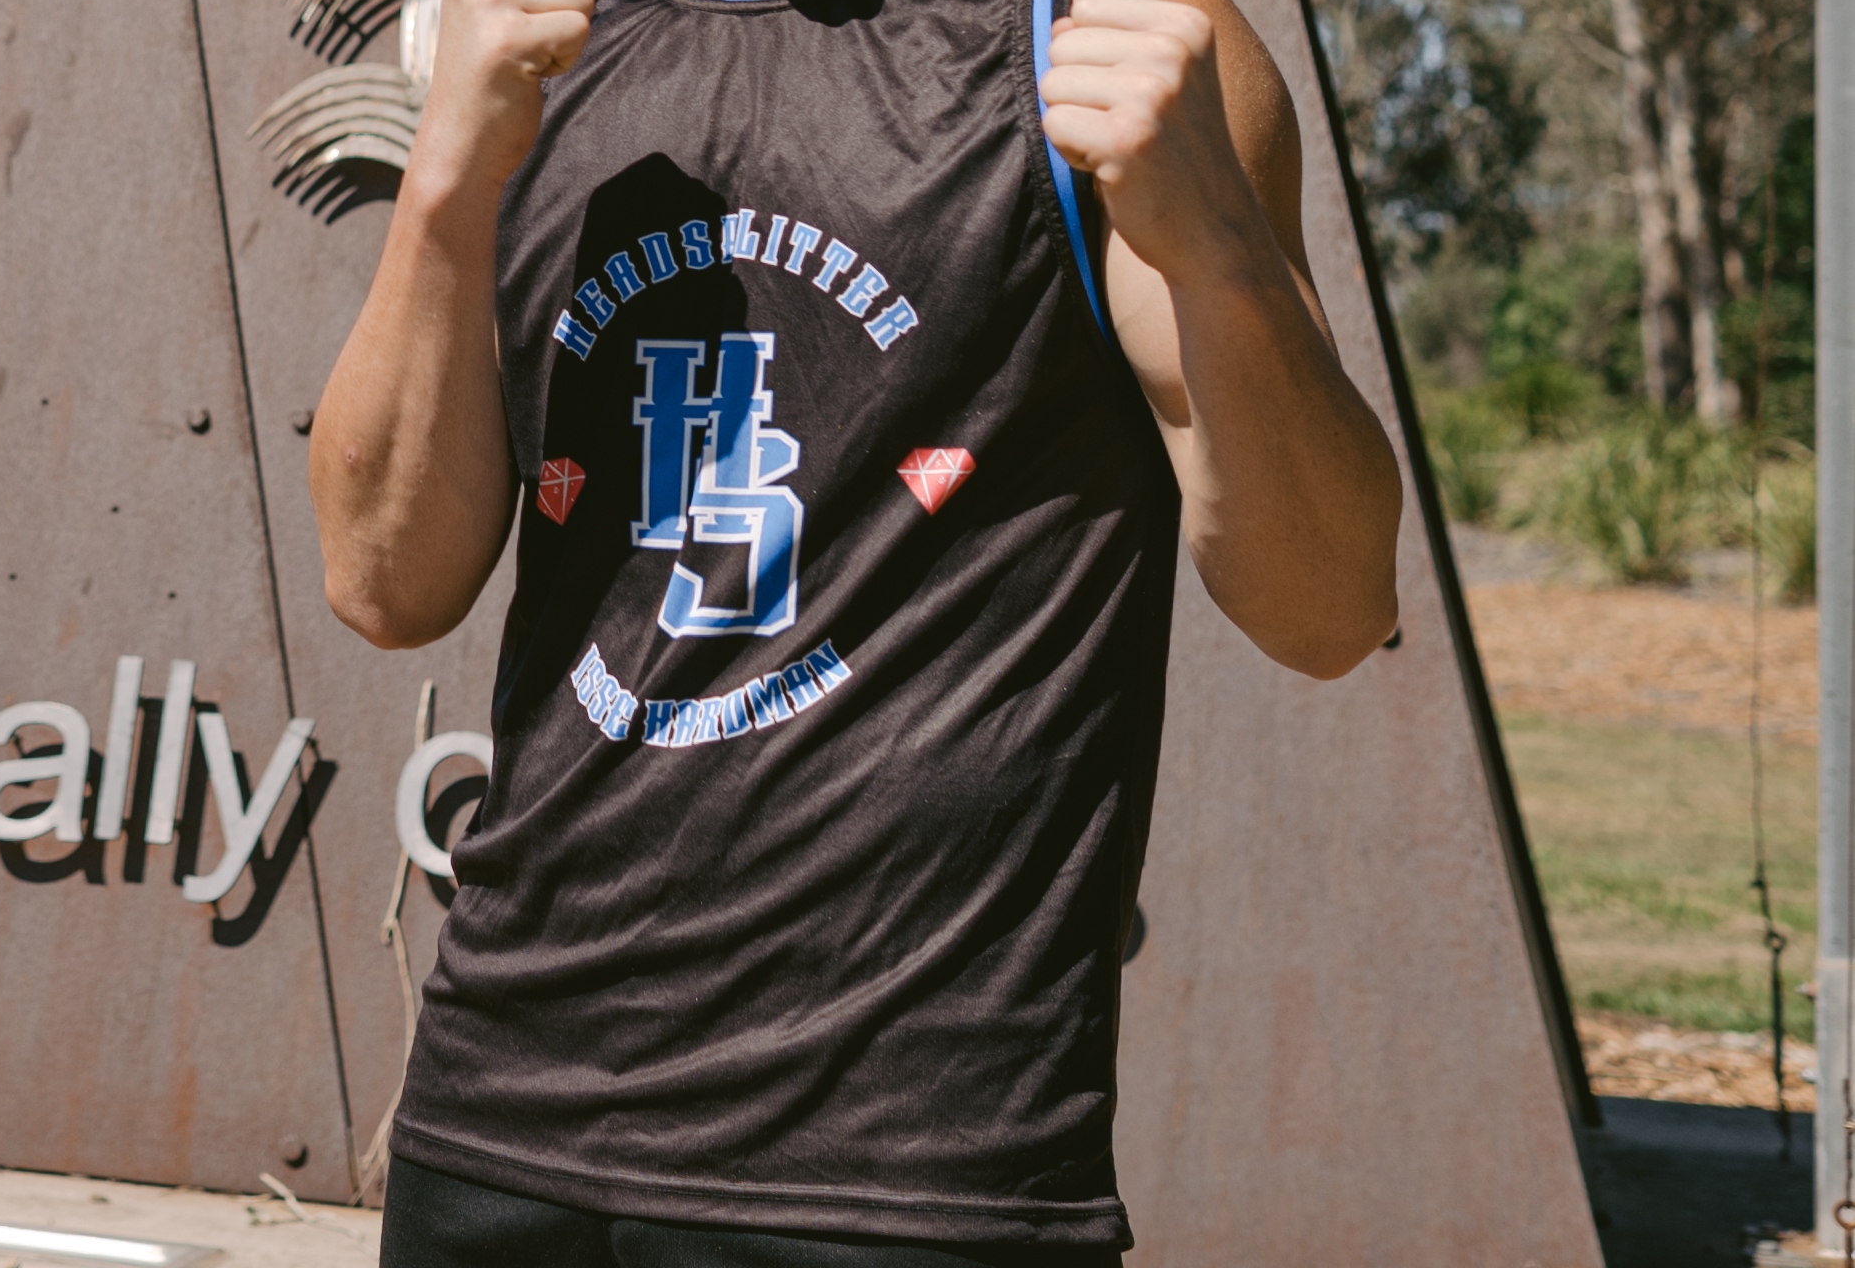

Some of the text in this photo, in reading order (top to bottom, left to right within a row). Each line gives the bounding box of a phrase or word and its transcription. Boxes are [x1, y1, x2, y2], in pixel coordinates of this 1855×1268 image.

[552, 207, 920, 362] HEADSPLITTER
[570, 637, 854, 749] ISSE HARDMAN
